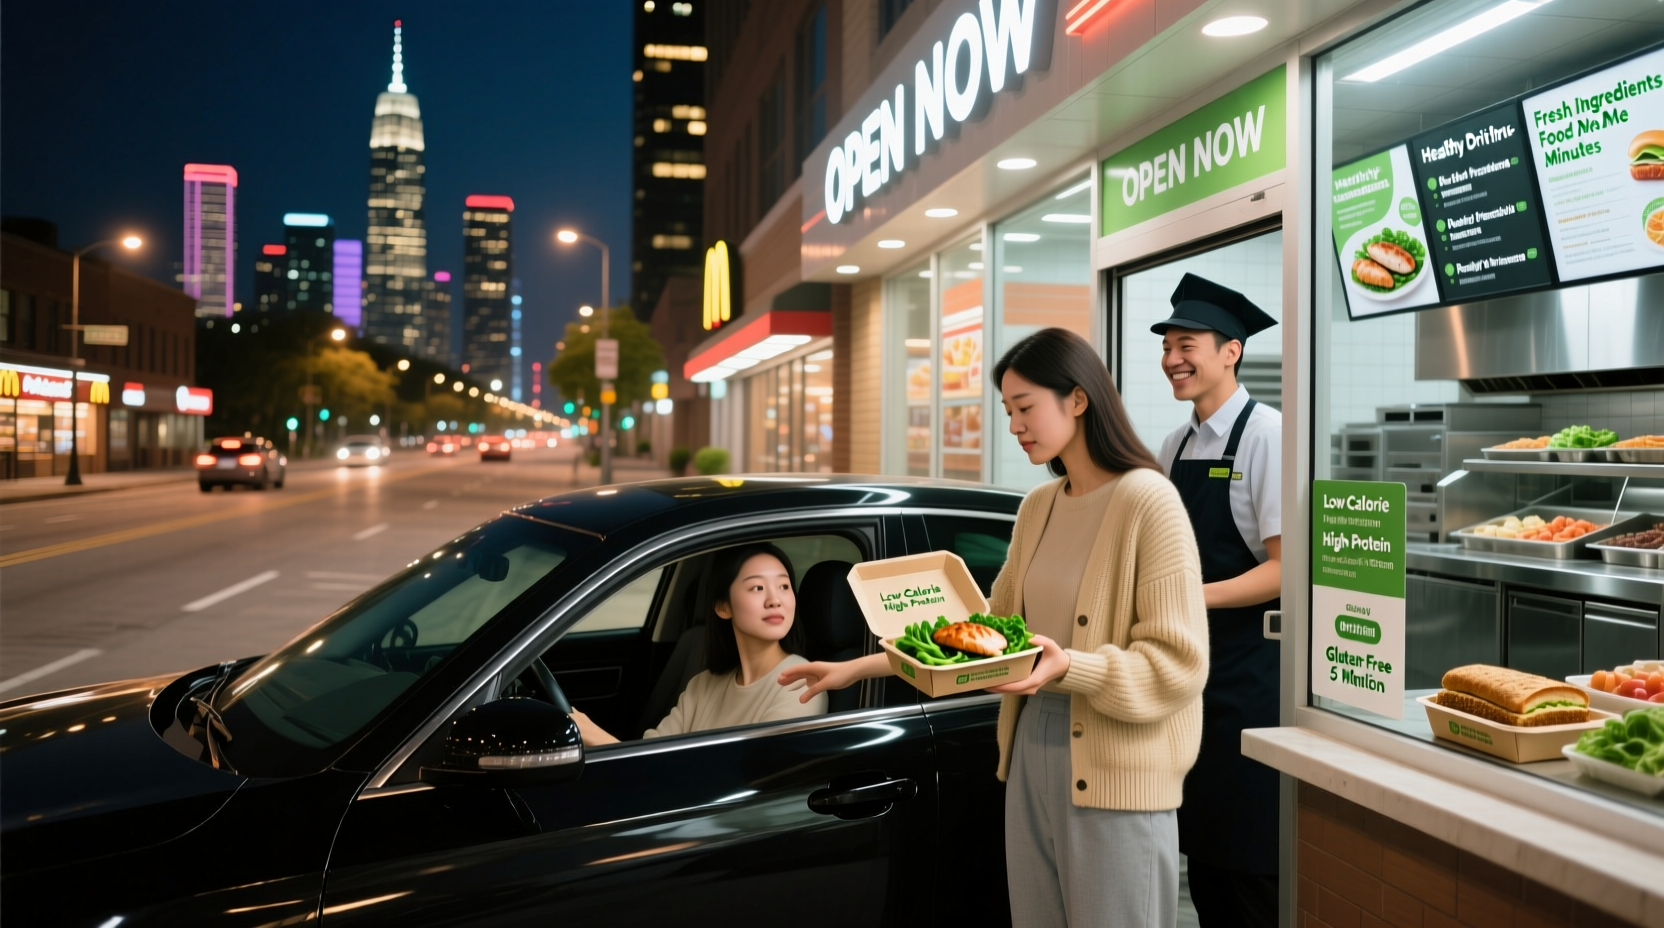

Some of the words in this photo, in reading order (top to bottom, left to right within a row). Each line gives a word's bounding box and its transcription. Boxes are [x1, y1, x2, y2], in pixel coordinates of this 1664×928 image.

[825, 83, 905, 224] OPEN
[915, 0, 1037, 155] NOW
[1534, 101, 1573, 129] Fresh
[1575, 74, 1663, 114] Ingredients
[1539, 122, 1574, 148] Food
[1122, 143, 1187, 207] OPEN
[1193, 105, 1266, 178] NOW
[1545, 141, 1602, 168] Minutes
[1323, 494, 1345, 509] Low
[1346, 495, 1390, 513] Calorie
[1323, 531, 1350, 552] High
[1330, 665, 1338, 681] 5
[1366, 654, 1392, 674] Free
